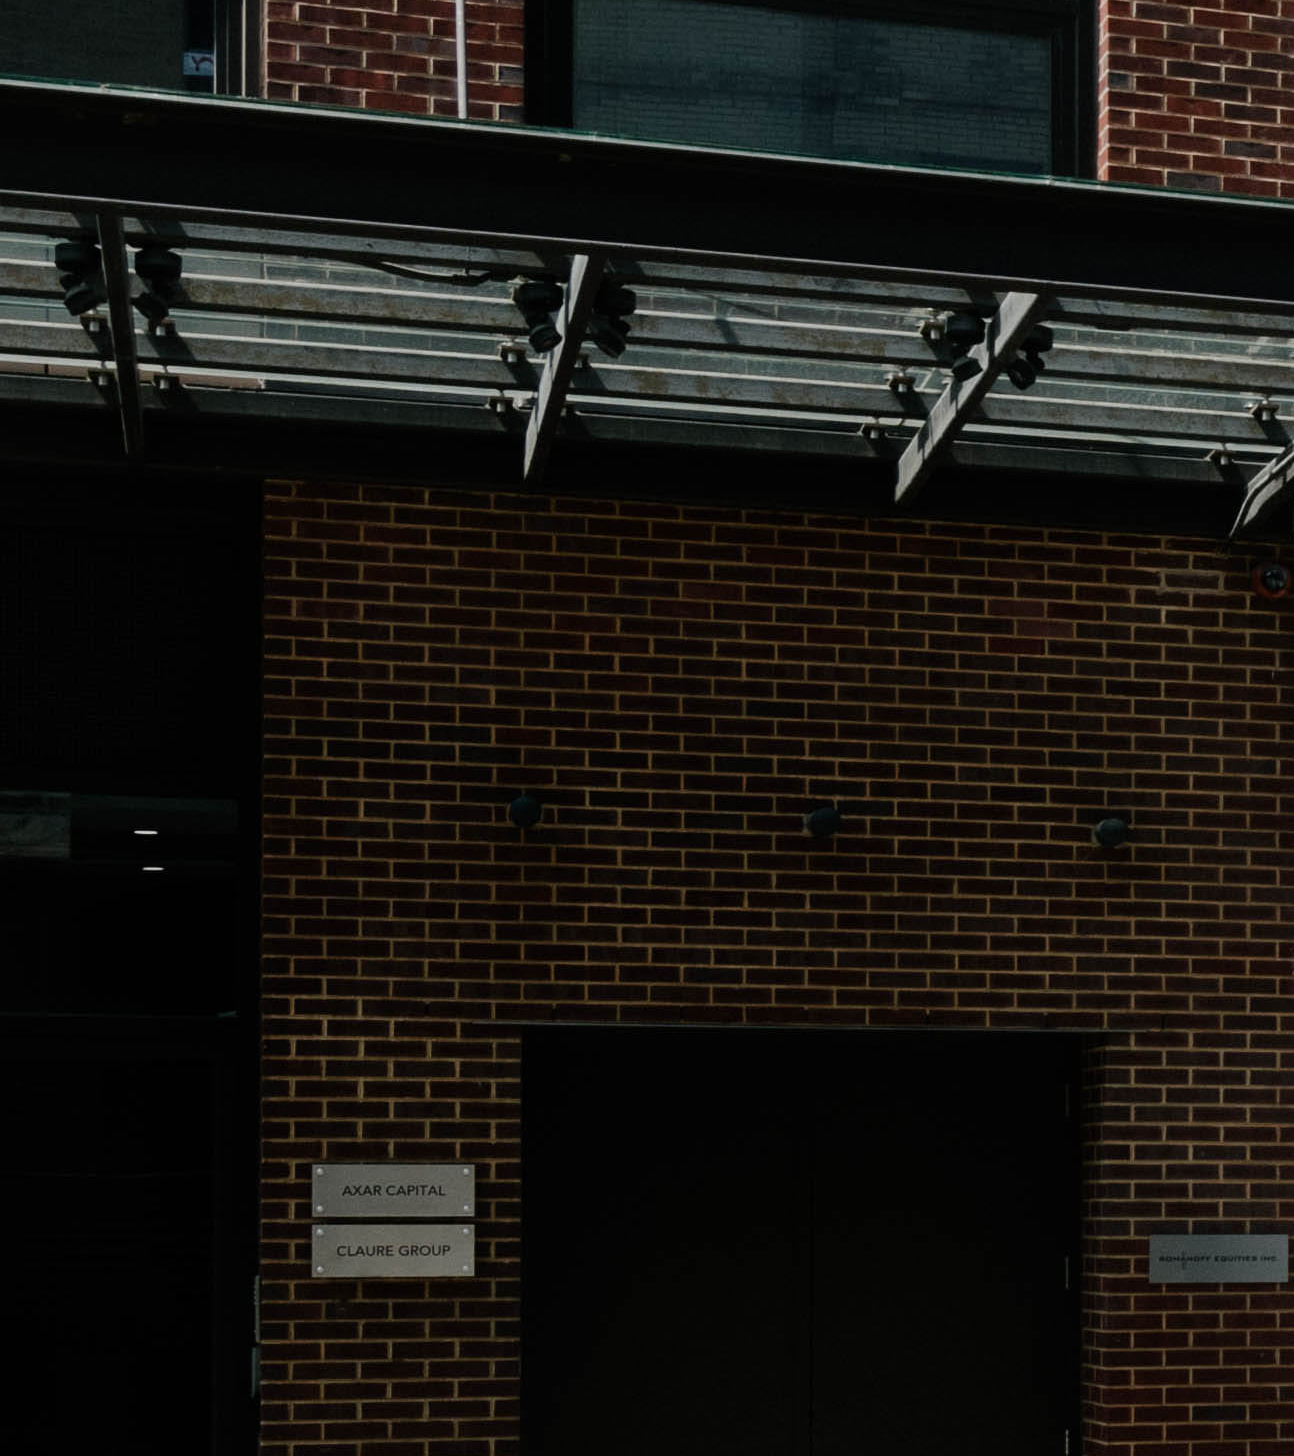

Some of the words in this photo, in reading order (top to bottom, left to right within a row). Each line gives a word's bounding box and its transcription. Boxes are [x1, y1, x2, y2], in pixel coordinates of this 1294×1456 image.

[342, 1185, 382, 1196] AXAR
[386, 1185, 447, 1196] CAPITAL
[336, 1245, 394, 1257] CLAURE
[398, 1245, 451, 1257] GROUP
[1214, 1255, 1258, 1263] EQUITIES
